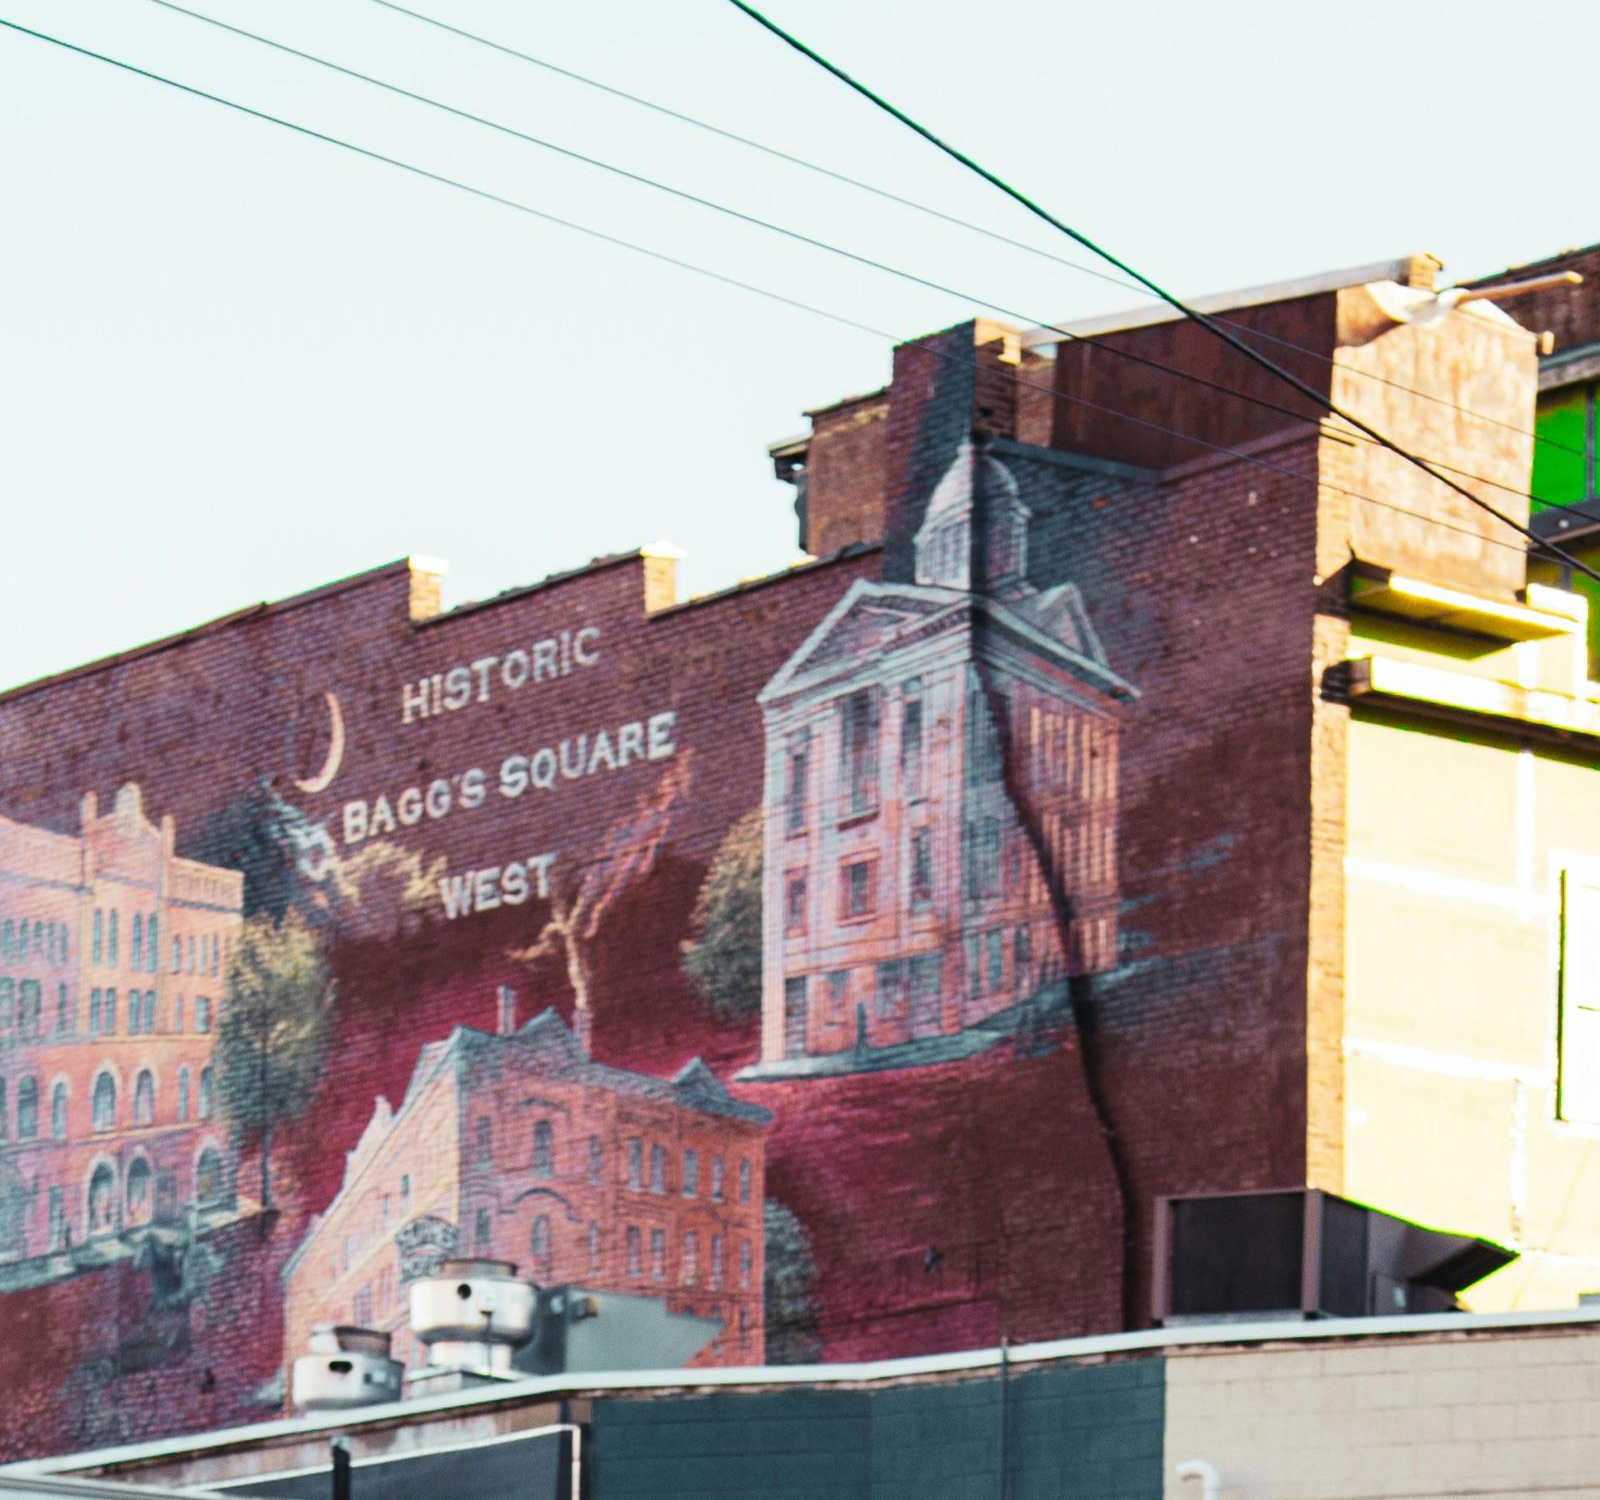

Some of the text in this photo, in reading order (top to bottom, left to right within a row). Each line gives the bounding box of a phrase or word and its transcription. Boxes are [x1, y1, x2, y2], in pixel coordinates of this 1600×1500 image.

[401, 627, 601, 724] HISTORIC
[342, 710, 679, 844] BAGG'S SQUARE
[437, 851, 559, 920] WEST
